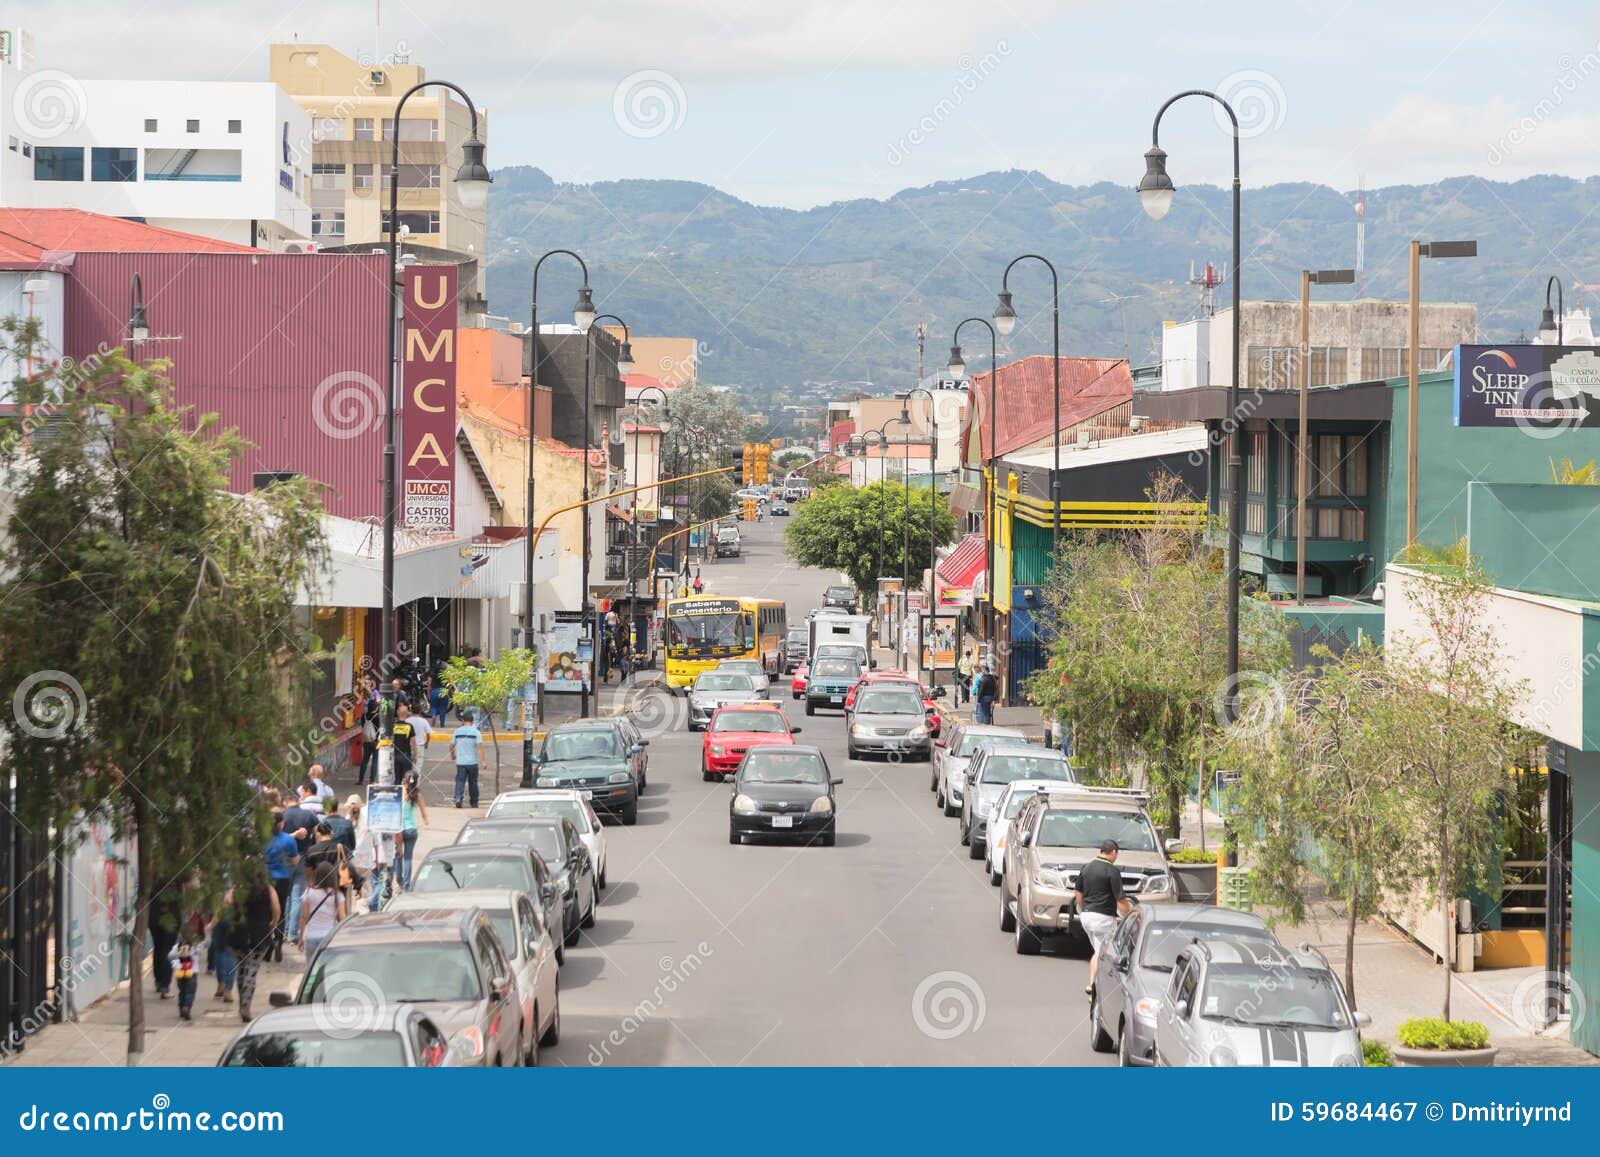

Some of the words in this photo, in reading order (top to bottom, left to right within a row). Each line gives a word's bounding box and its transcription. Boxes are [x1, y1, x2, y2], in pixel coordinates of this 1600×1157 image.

[406, 275, 453, 466] UMCA
[1571, 368, 1598, 376] CASINO
[1472, 365, 1529, 393] SLEEP
[1484, 391, 1519, 405] INN
[407, 483, 449, 495] UMCA
[406, 507, 449, 516] CASTRO
